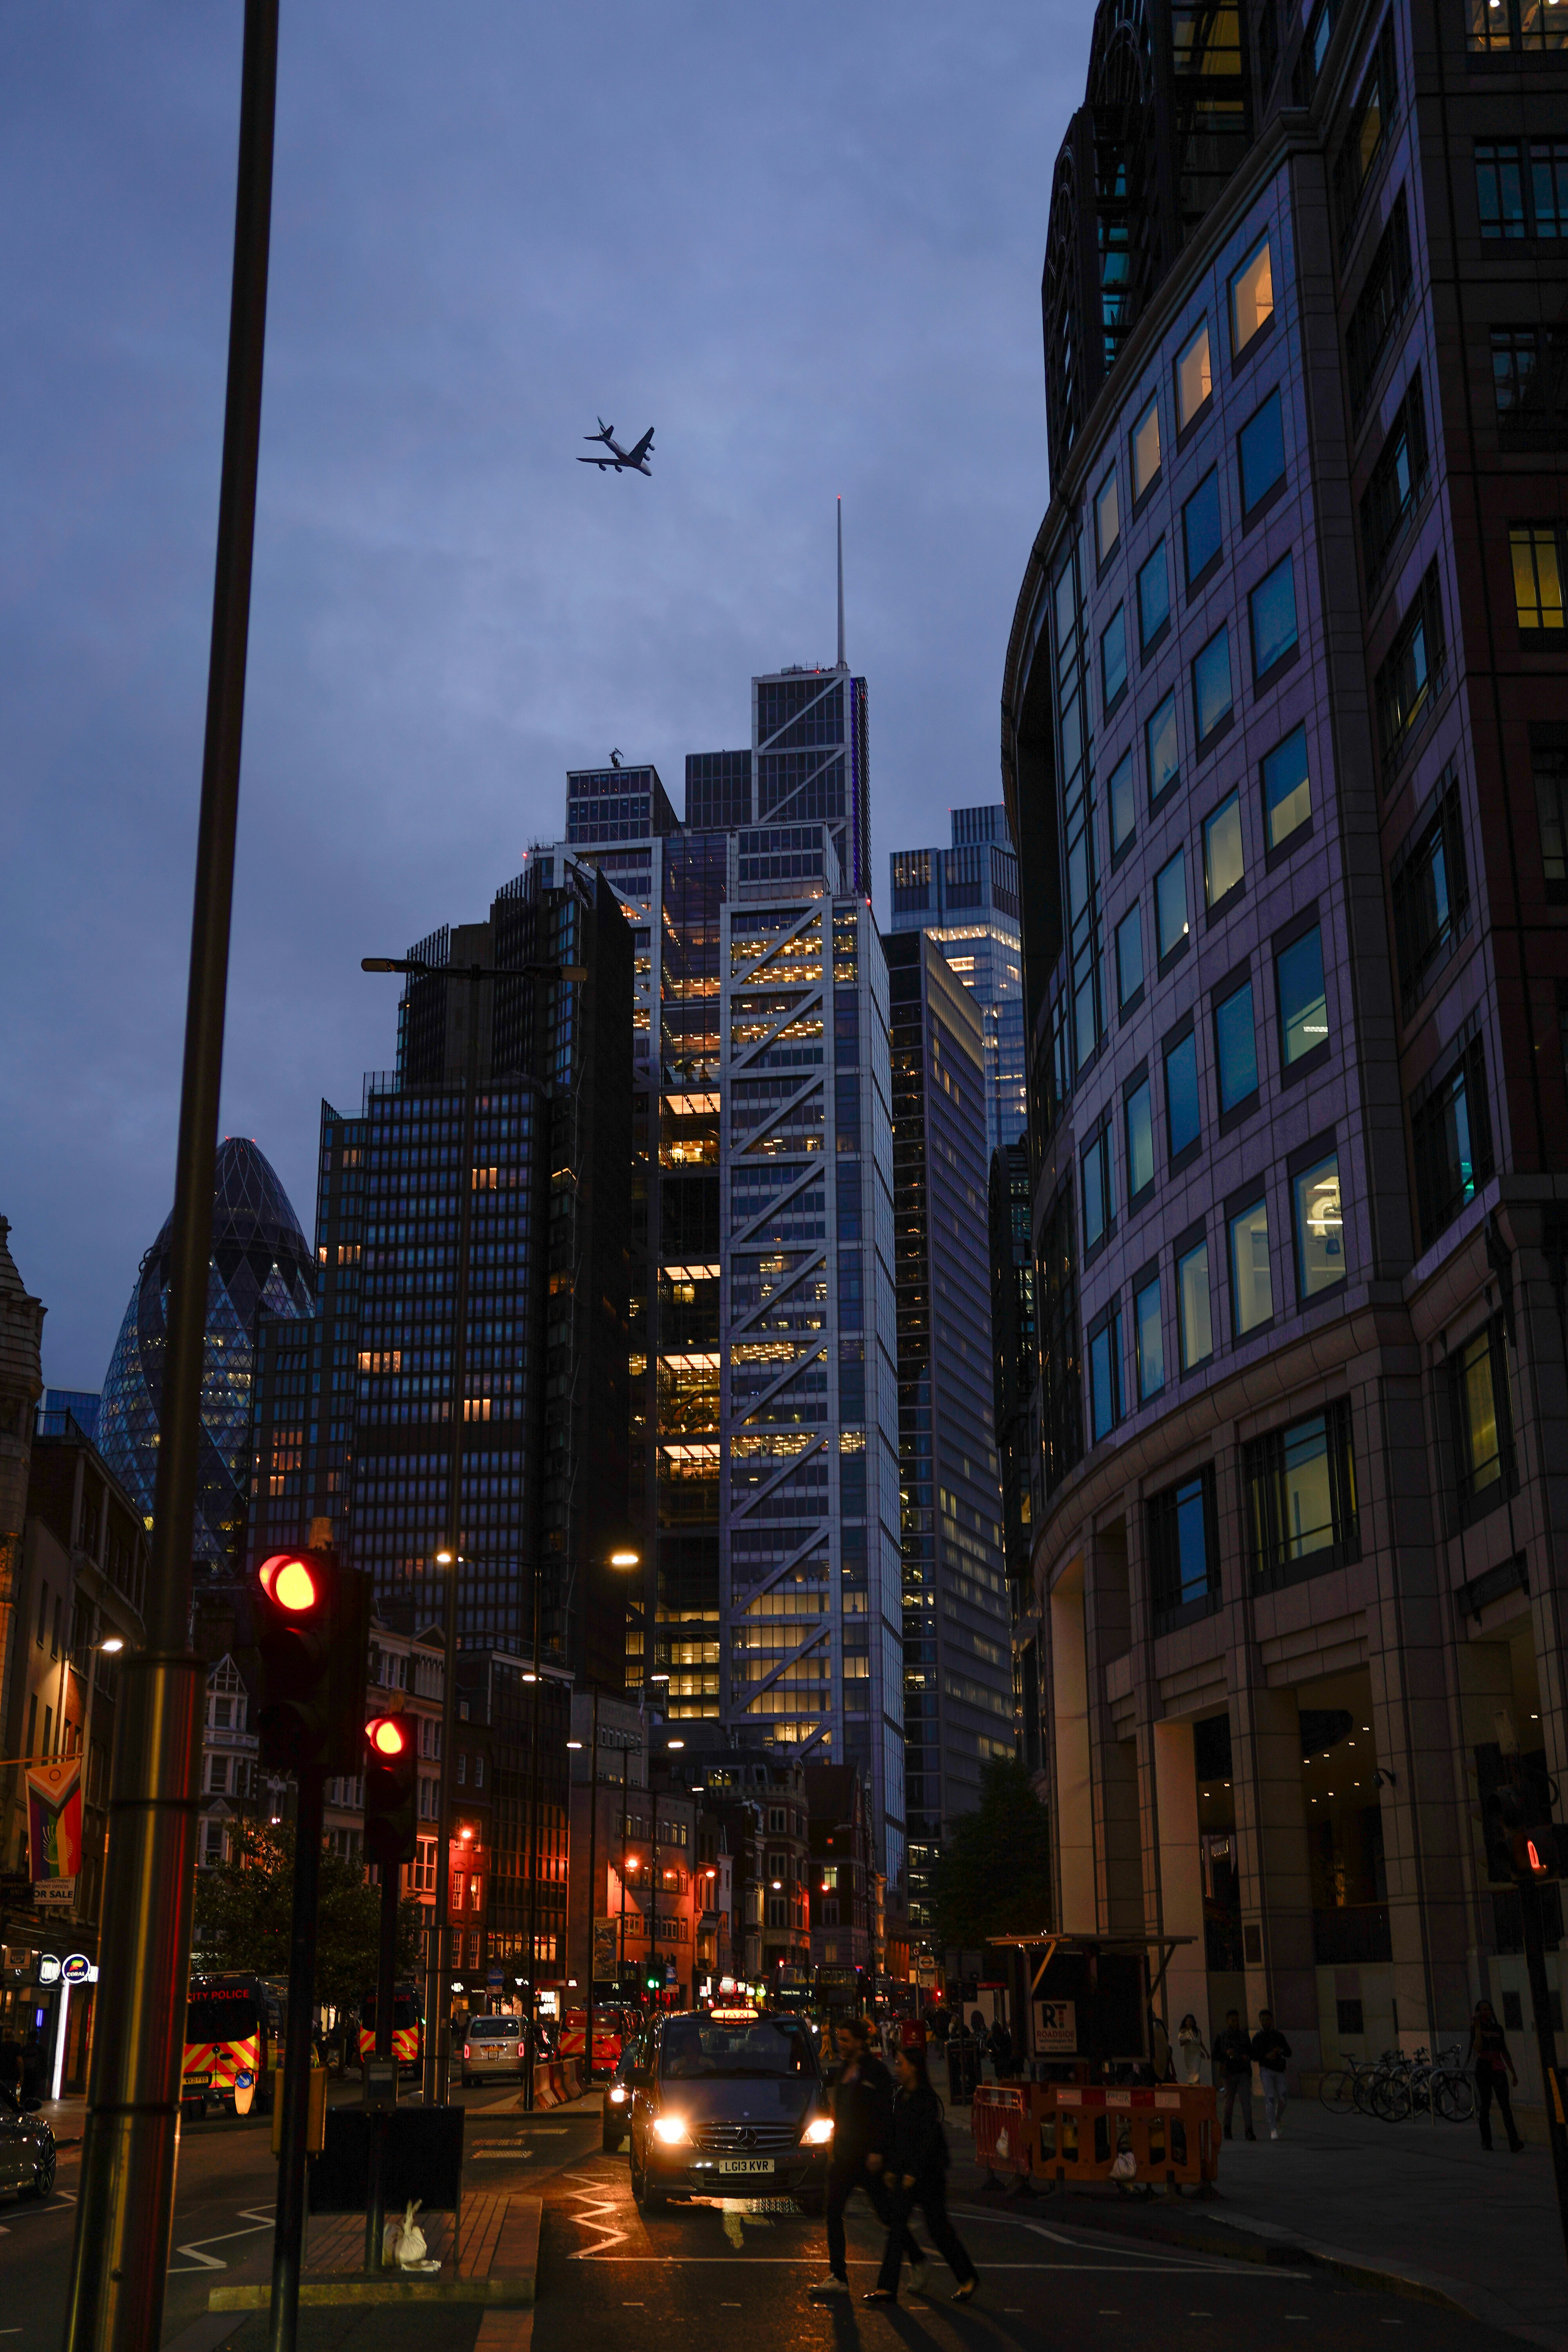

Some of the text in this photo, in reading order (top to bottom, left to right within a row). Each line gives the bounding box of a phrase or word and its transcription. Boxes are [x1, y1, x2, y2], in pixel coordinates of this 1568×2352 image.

[187, 1989, 249, 2002] CITY POLICE
[541, 1991, 555, 2003] FIVE
[539, 2003, 557, 2014] GUYS
[721, 2011, 750, 2019] TAXI
[1042, 2004, 1067, 2029] RT
[725, 2161, 768, 2171] LG13 KVR
